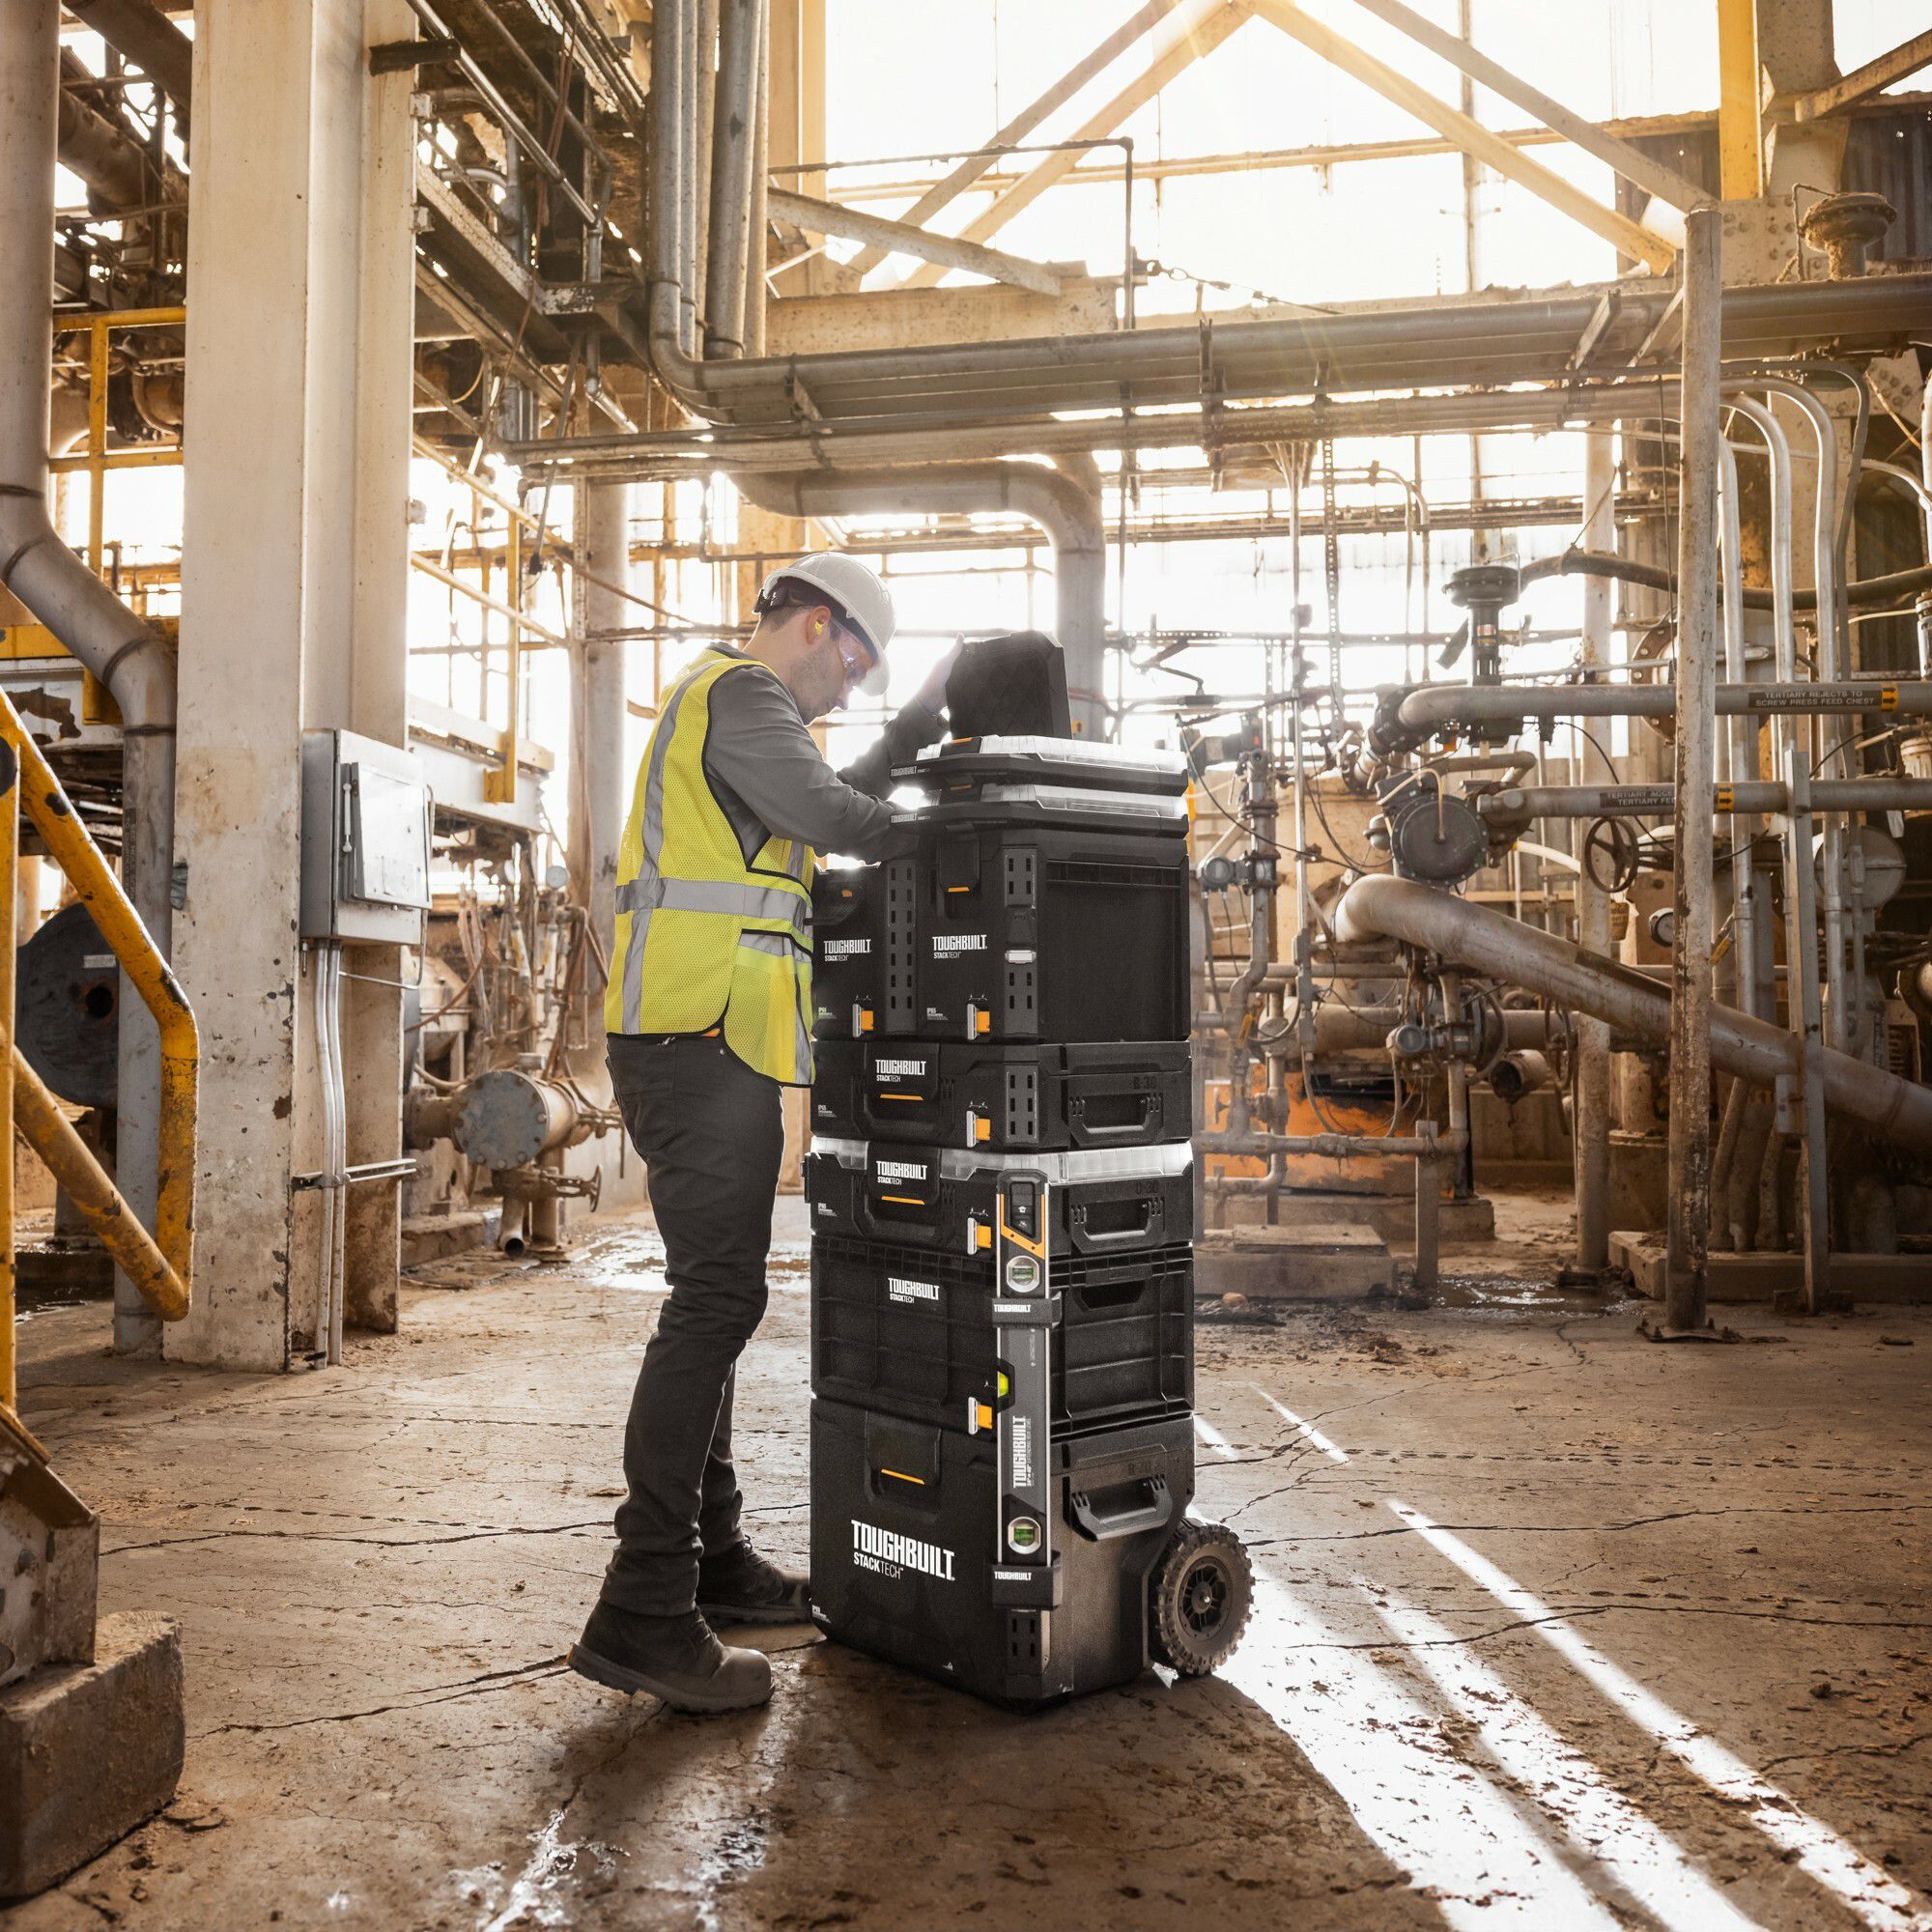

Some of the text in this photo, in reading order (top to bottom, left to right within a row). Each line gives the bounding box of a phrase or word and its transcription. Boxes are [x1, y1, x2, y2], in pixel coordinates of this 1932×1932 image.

[1765, 691, 1806, 699] TERTIARY
[1809, 690, 1848, 698] REJECTS
[1755, 698, 1787, 707] SCREW
[891, 765, 917, 777] TOUGHBUILT
[891, 812, 917, 823] TOUGHBUILT
[823, 939, 871, 954] TOUGHBUILT
[931, 934, 987, 951] TOUGHBUILT
[875, 1059, 926, 1075] TOUGHBUILT
[876, 1160, 927, 1179] TOUGHBUILT
[877, 1177, 902, 1185] STACKTECH
[888, 1277, 940, 1301] TOUGHBUILT
[889, 1293, 915, 1304] STACKTECH
[993, 1304, 1032, 1313] TOUGHBUILT
[1012, 1415, 1027, 1488] TOUGHBUILT
[851, 1520, 955, 1581] TOUGHBUILT
[994, 1571, 1033, 1581] TOUGHBUILT
